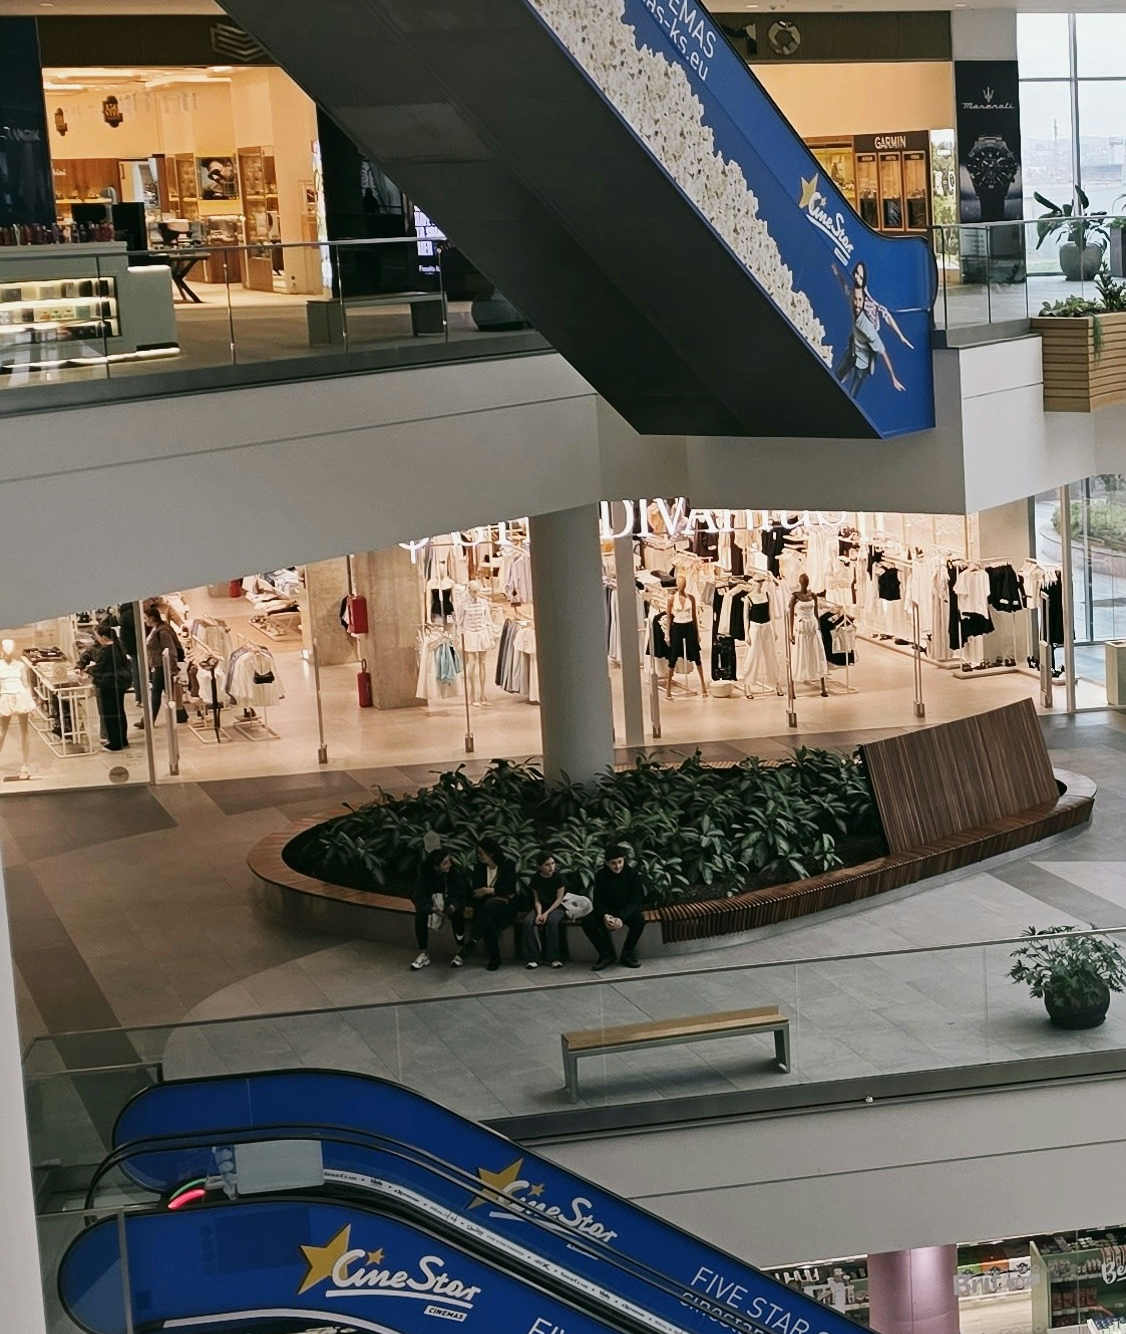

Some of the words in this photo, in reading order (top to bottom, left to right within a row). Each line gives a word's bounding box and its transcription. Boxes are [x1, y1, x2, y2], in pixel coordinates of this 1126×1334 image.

[874, 136, 907, 150] GARMIN
[808, 192, 855, 253] CineStar
[331, 1248, 482, 1301] CineStar
[690, 1266, 748, 1309] FIVE
[953, 1274, 998, 1297] Brit
[428, 1307, 465, 1321] CINEMAS
